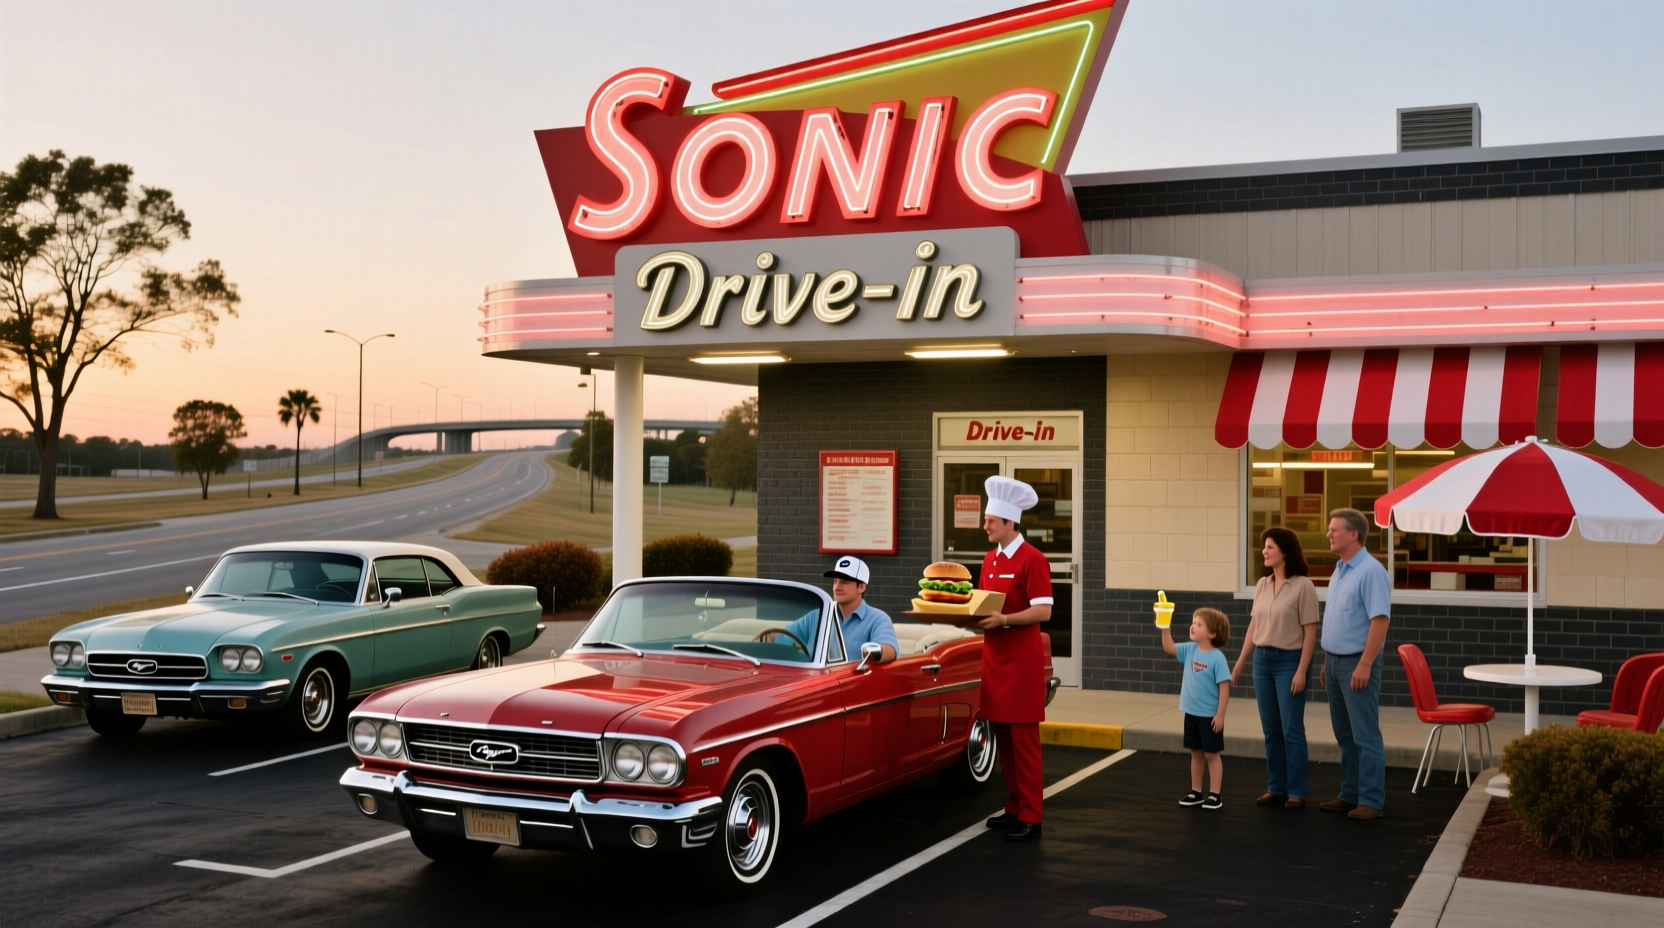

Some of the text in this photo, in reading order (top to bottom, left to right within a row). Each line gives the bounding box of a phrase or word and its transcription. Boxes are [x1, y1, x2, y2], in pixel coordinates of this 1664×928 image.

[568, 67, 1060, 240] SONIC
[636, 241, 985, 332] Drive-in
[966, 420, 1055, 441] Drive-in
